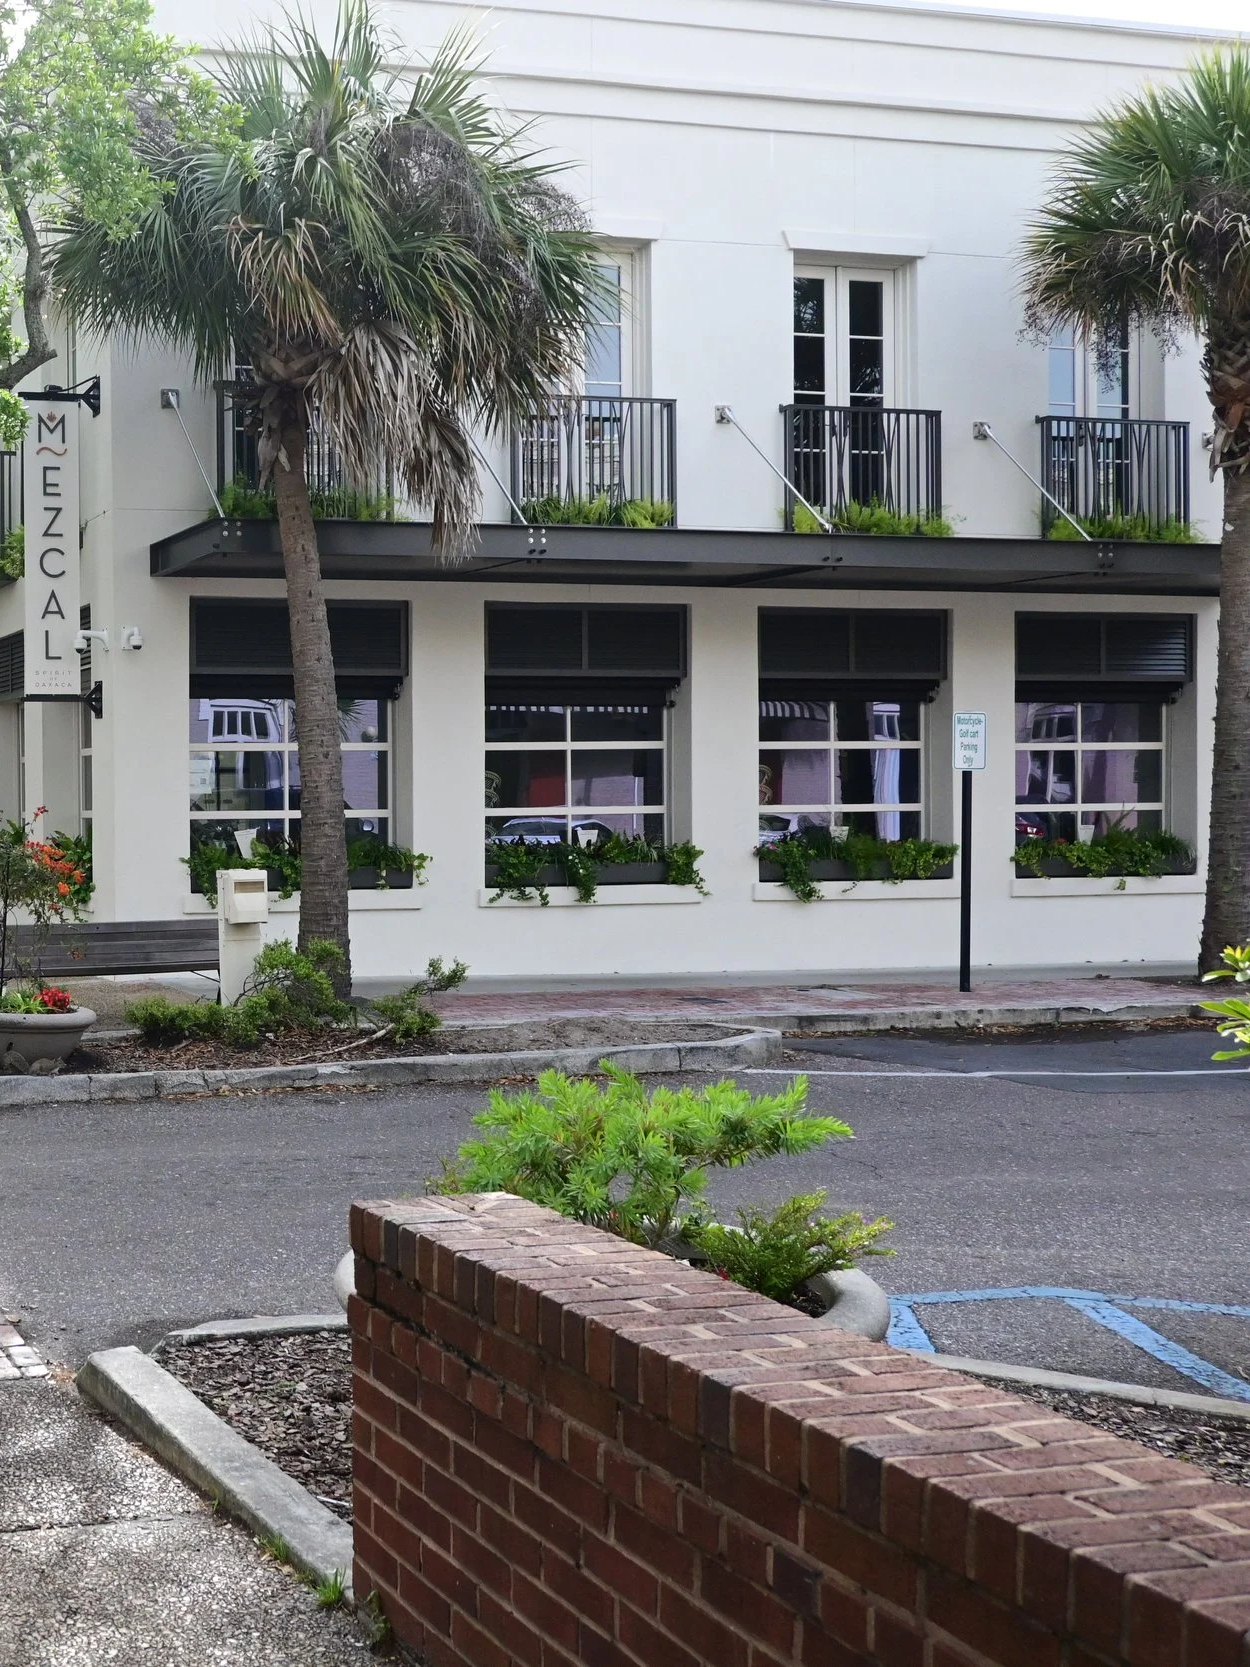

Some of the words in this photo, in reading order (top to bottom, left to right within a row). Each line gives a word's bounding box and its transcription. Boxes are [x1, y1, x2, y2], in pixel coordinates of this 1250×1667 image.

[37, 411, 67, 660] MEZCAL
[960, 742, 978, 753] Parking
[962, 755, 974, 767] Only
